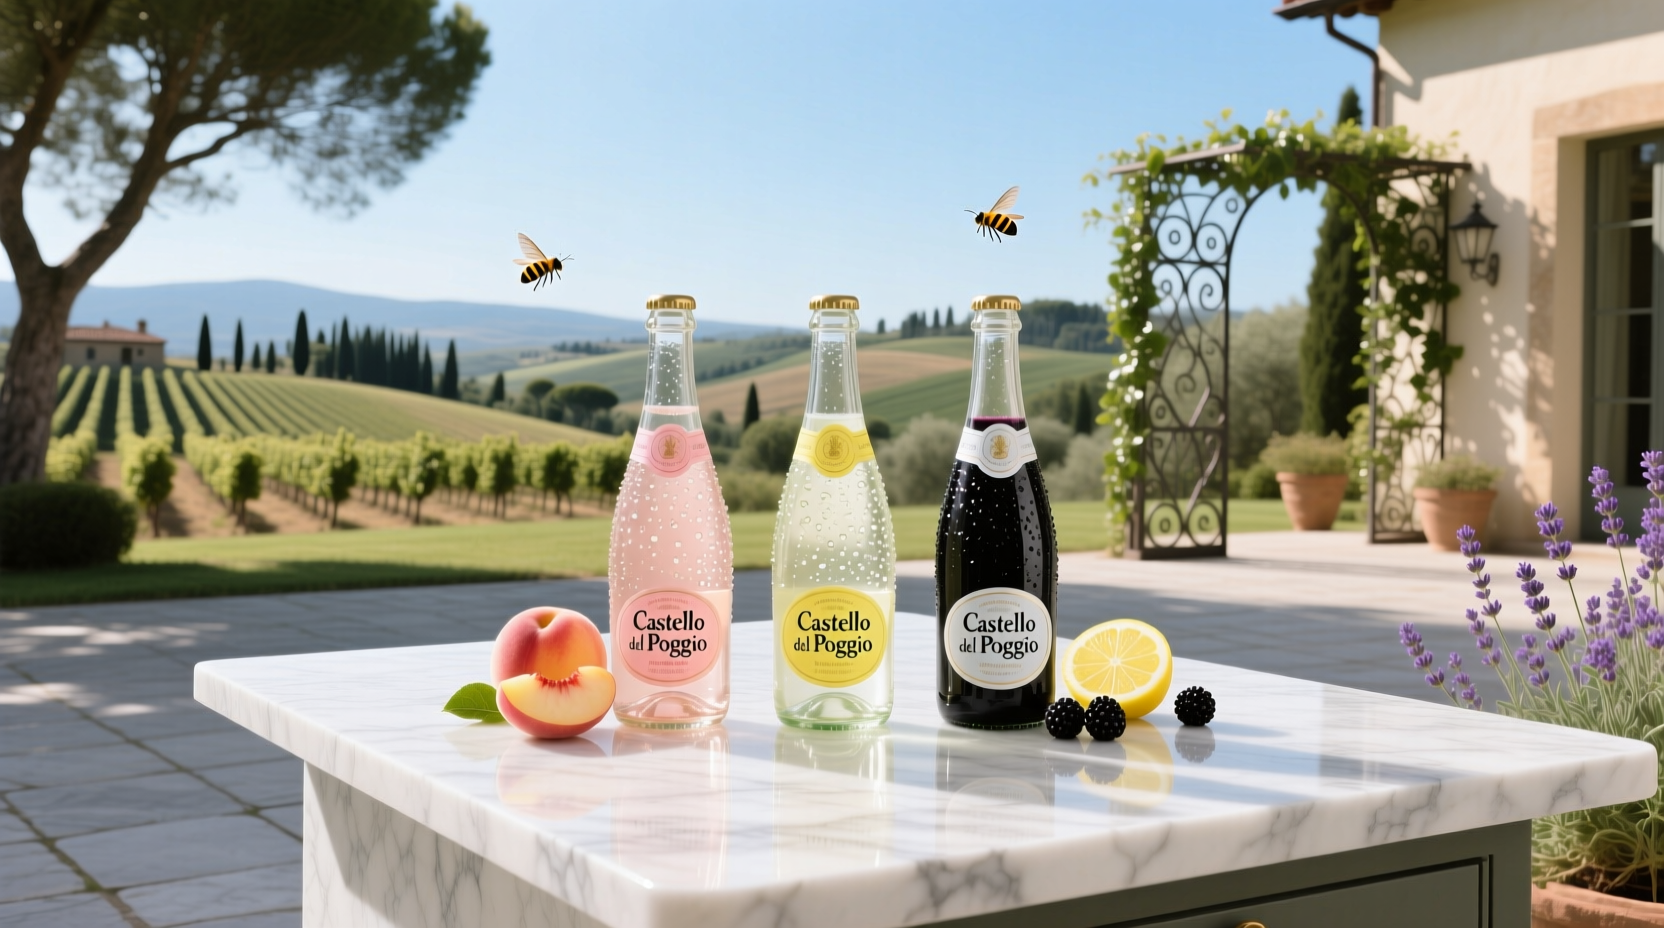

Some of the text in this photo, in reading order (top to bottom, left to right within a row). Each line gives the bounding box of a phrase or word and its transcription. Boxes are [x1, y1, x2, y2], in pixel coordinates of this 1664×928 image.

[633, 610, 705, 631] Castello
[797, 611, 871, 632] Castello
[963, 612, 1036, 633] Castello
[647, 633, 707, 658] Poggio
[814, 634, 873, 659] Poggio
[959, 635, 1038, 660] del Poggio
